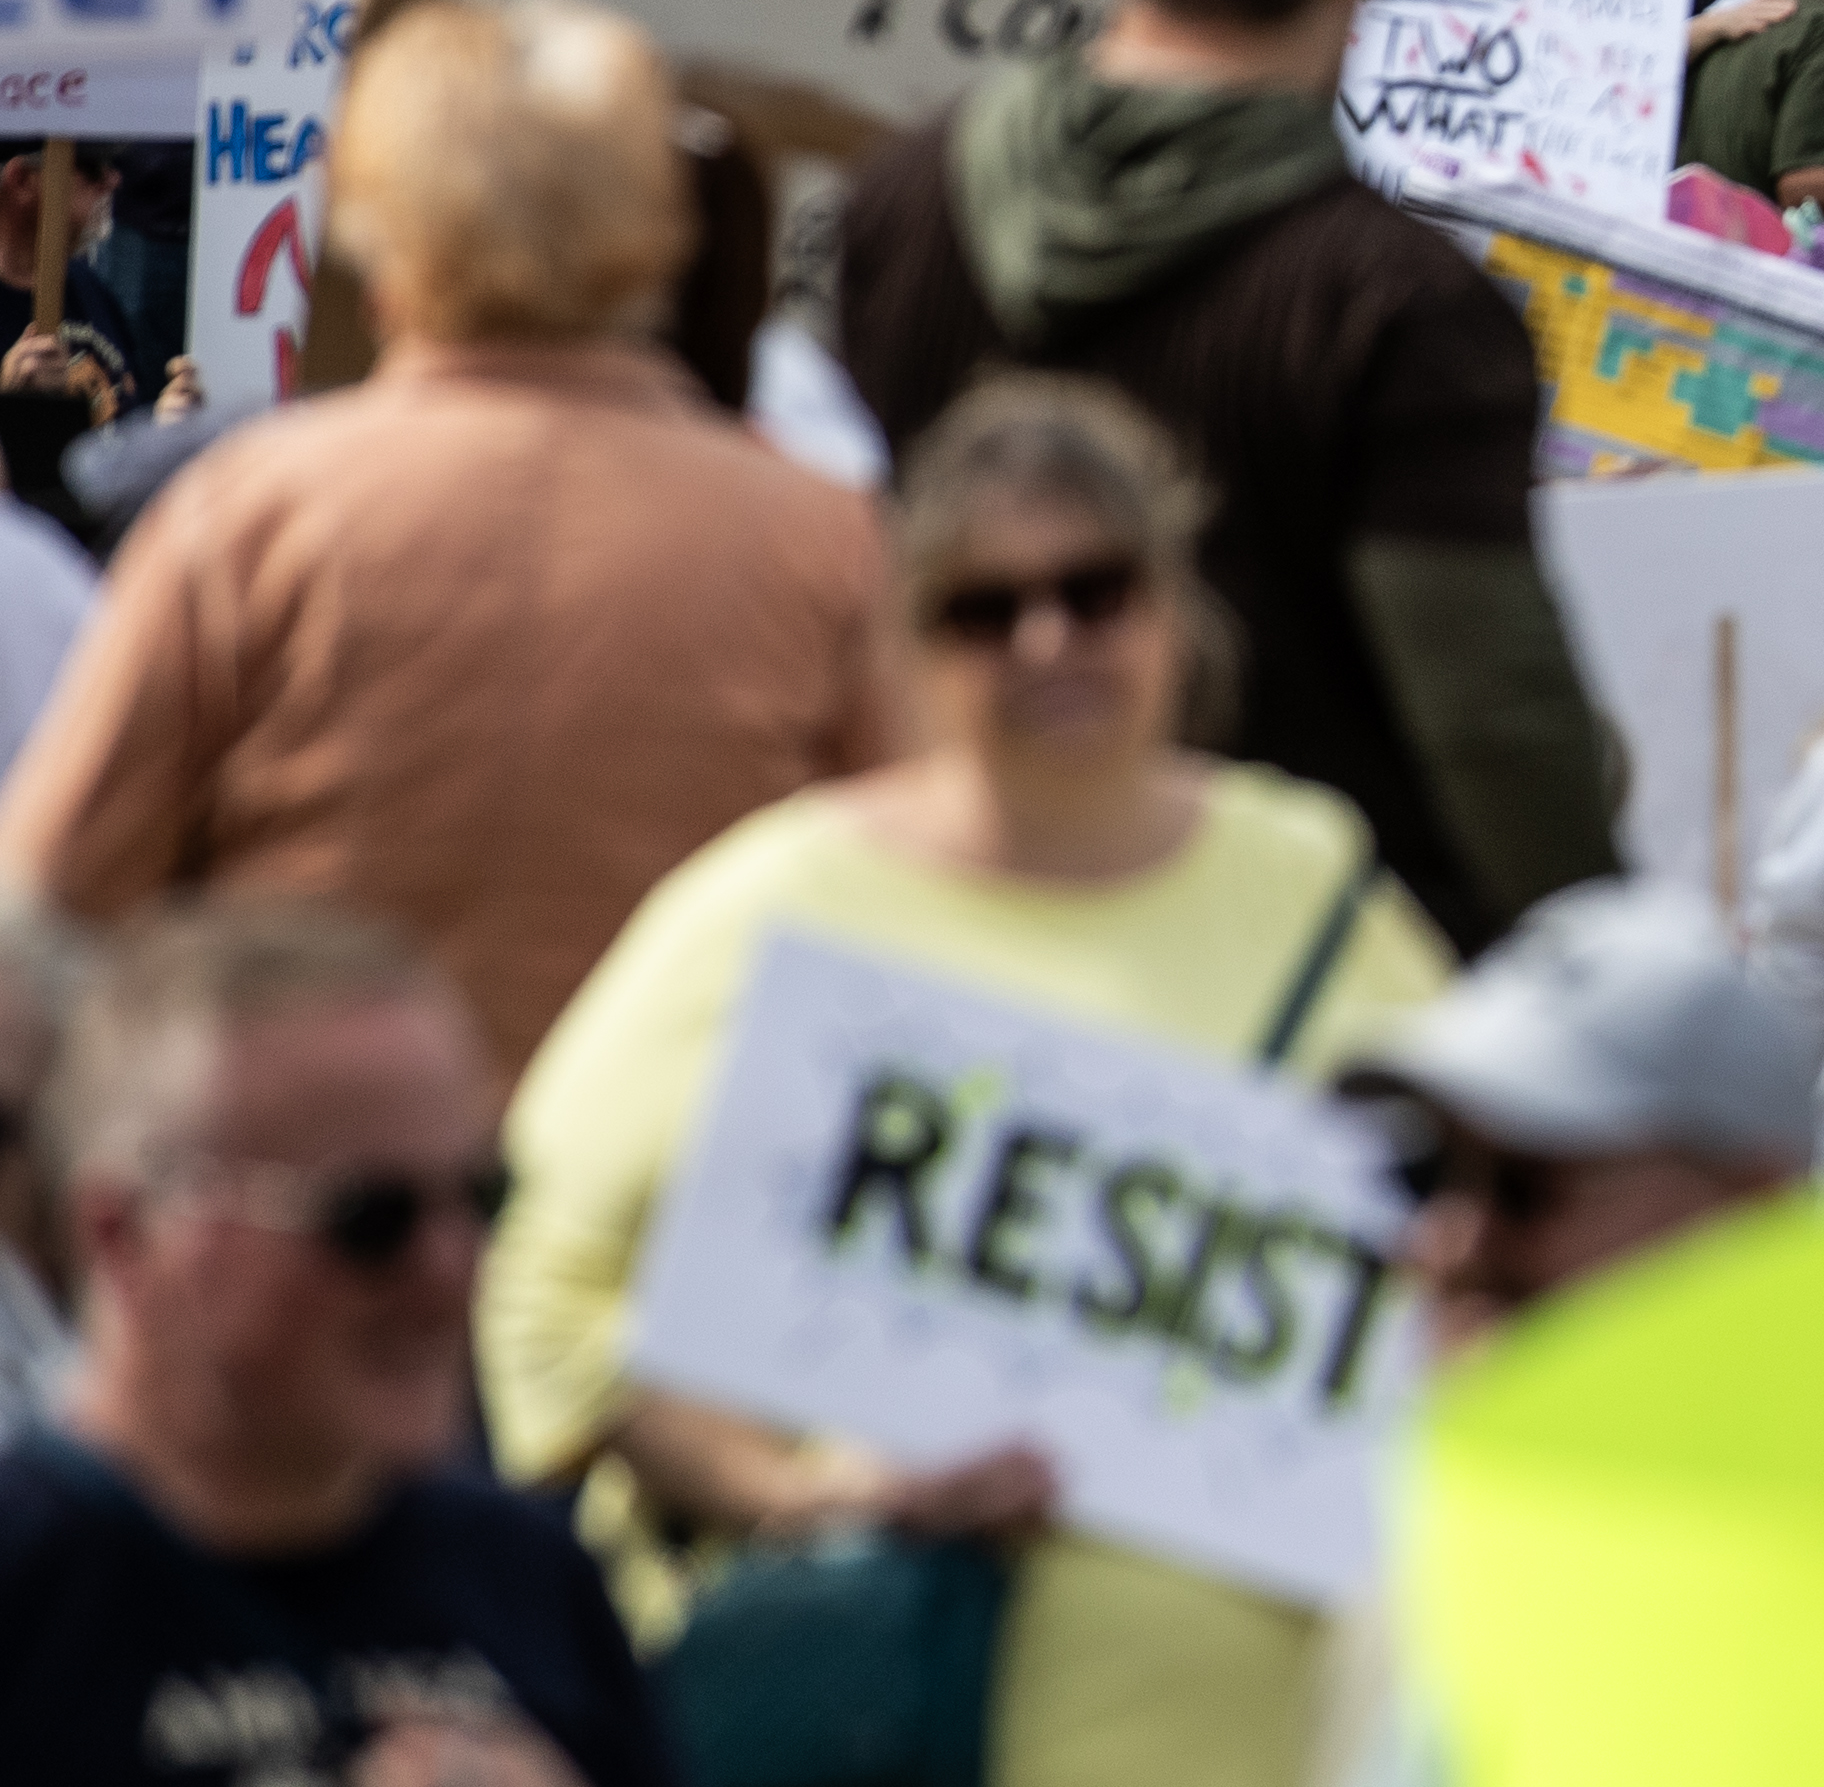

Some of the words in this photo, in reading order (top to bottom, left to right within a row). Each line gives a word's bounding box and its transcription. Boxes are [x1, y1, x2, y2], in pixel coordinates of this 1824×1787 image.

[1362, 10, 1523, 87] TWO
[1339, 89, 1528, 152] WHAT
[818, 1067, 1414, 1418] RESIST
